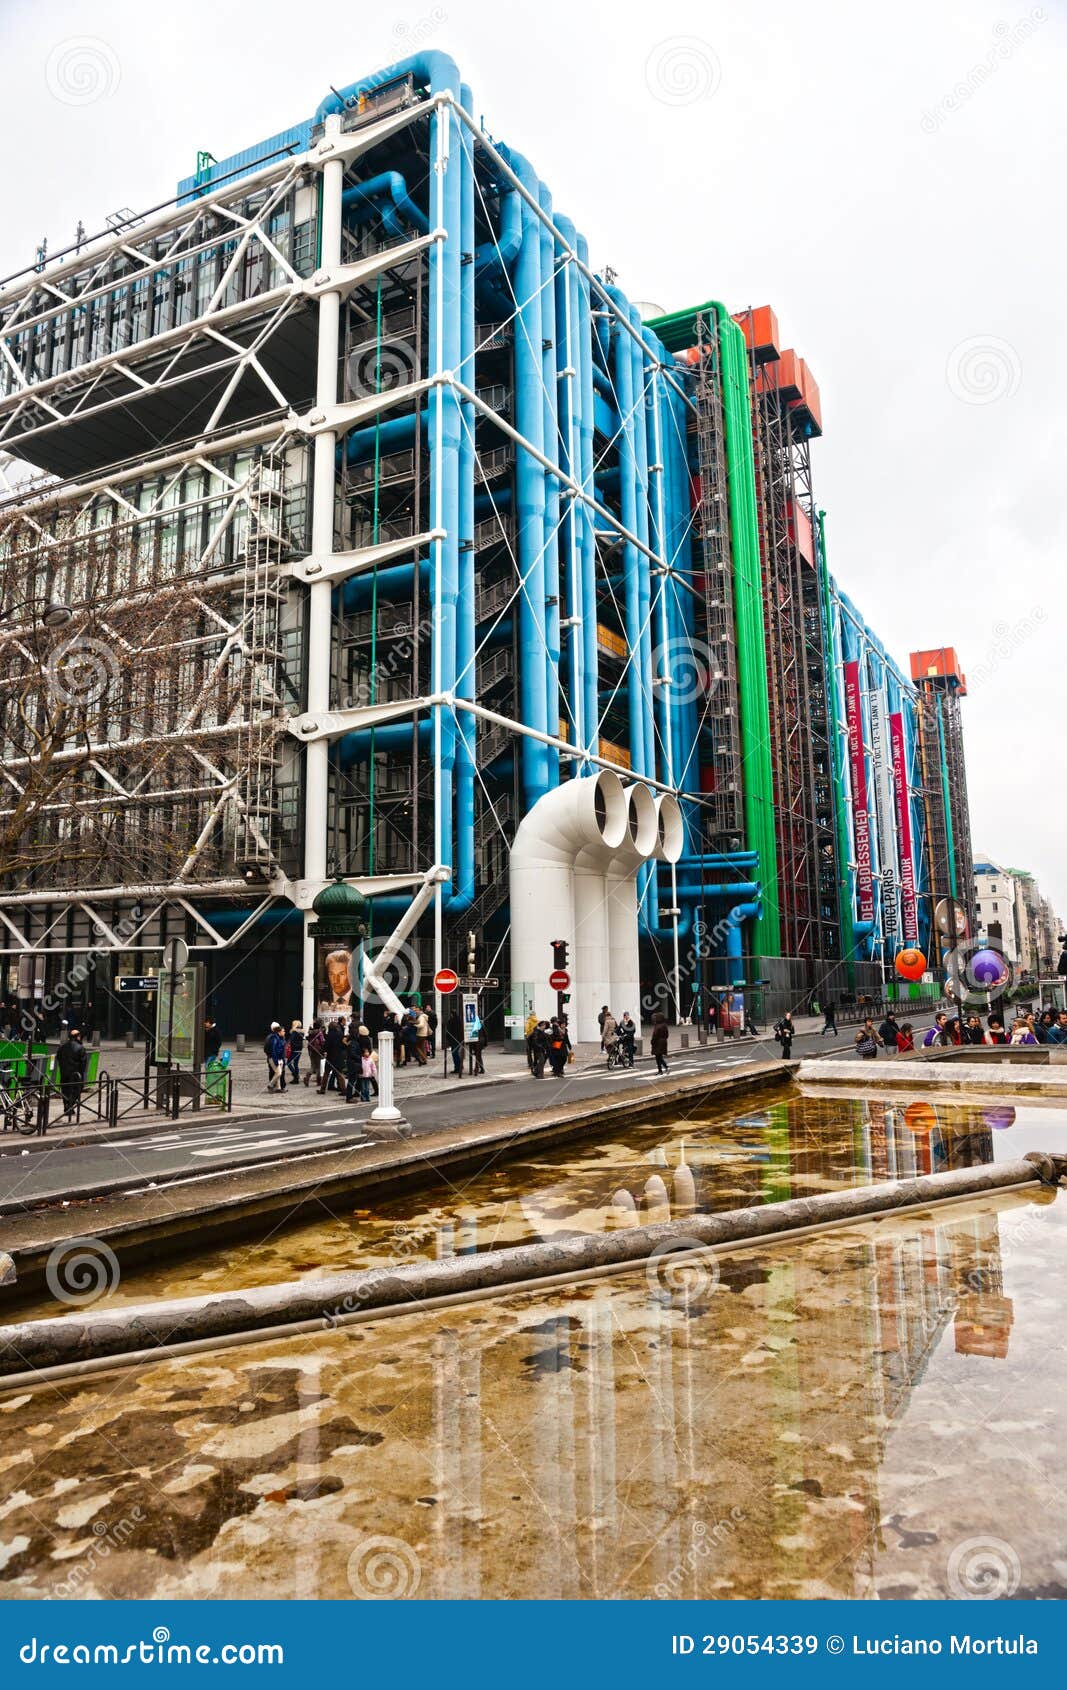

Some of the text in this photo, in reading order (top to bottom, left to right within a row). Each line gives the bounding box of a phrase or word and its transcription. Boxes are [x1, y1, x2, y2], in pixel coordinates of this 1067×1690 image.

[855, 809, 872, 892] ABDESSEMED
[882, 868, 895, 901] PARIS
[901, 857, 913, 897] CANTOR
[884, 904, 897, 934] VOICI
[904, 899, 917, 939] MIRCEA
